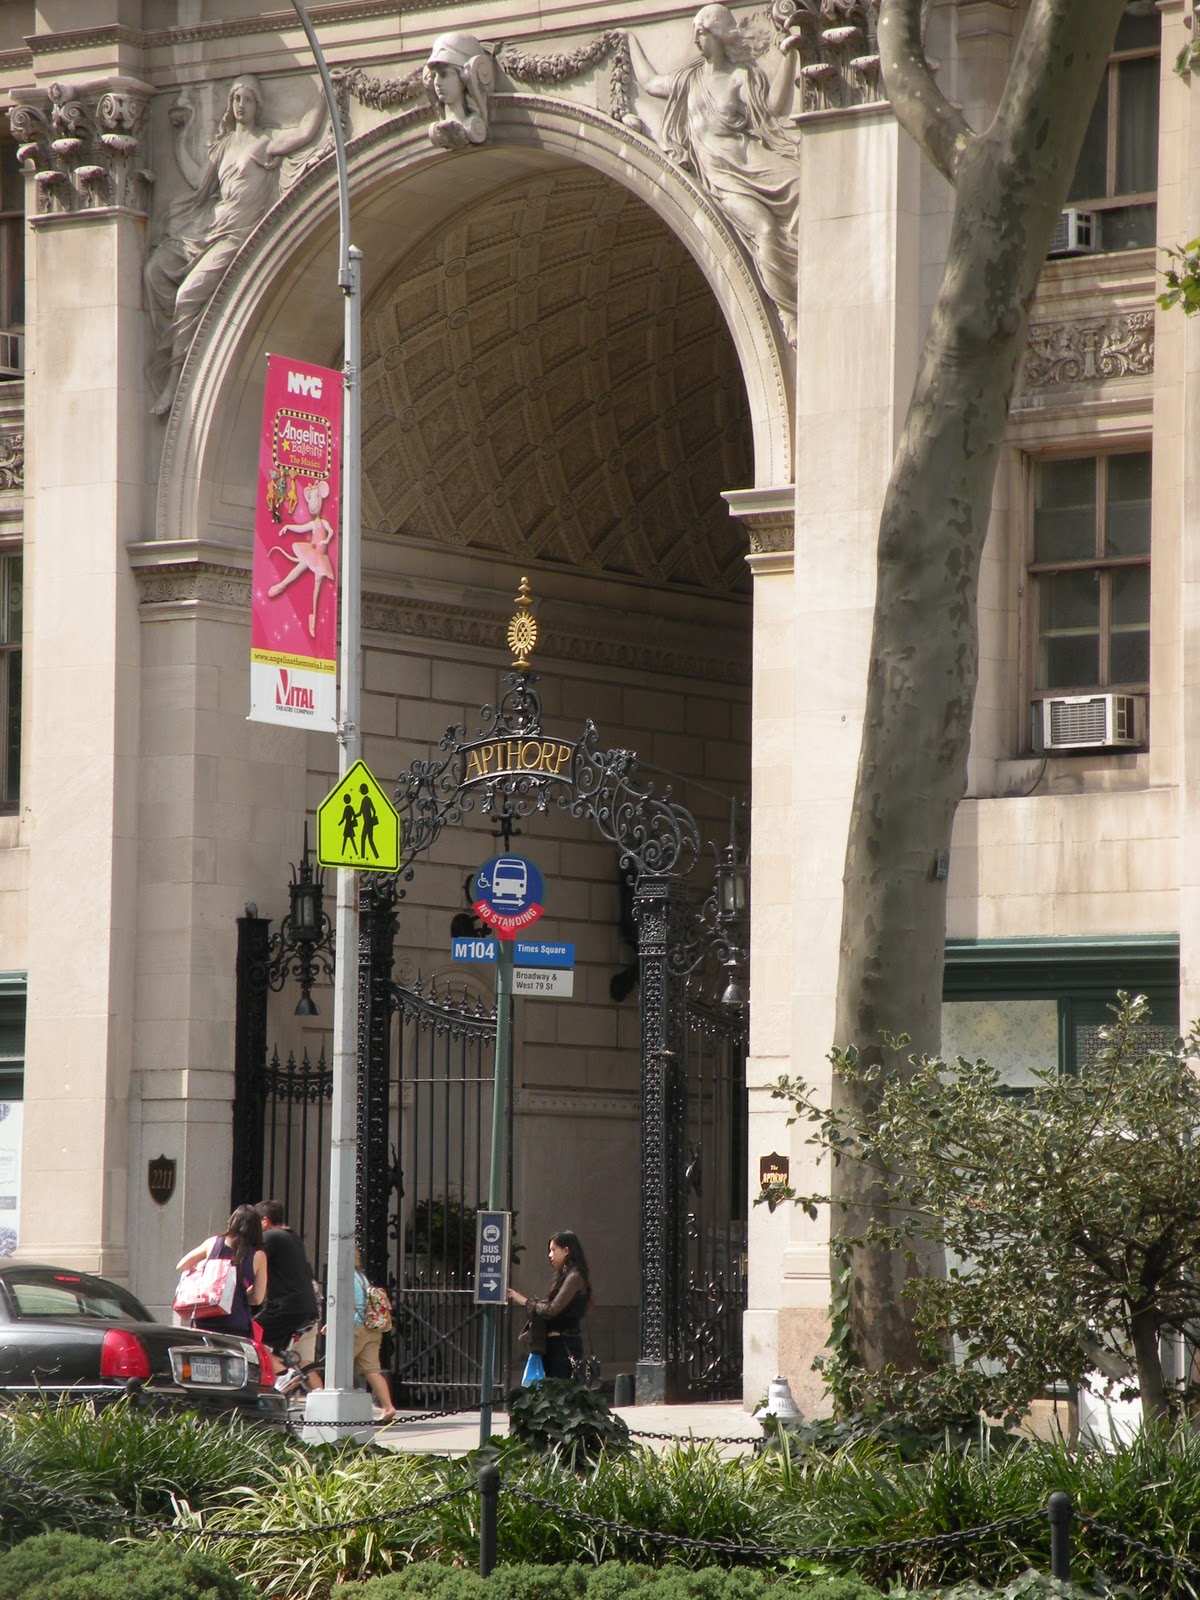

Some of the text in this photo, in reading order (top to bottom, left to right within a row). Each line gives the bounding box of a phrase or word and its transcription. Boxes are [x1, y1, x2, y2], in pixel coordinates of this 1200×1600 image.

[287, 371, 323, 399] NYC
[279, 419, 326, 448] Angelina
[291, 440, 323, 459] Ballerina
[289, 454, 301, 464] The
[294, 707, 314, 715] COMPANY
[464, 740, 571, 781] APTHORP
[478, 904, 537, 927] NO STANDING
[455, 942, 495, 959] M104
[517, 944, 566, 955] Times Square
[516, 971, 550, 981] Broadway
[516, 982, 553, 991] West 79 St
[151, 1169, 172, 1189] 2211
[482, 1245, 499, 1253] BUS
[480, 1255, 501, 1263] STOP
